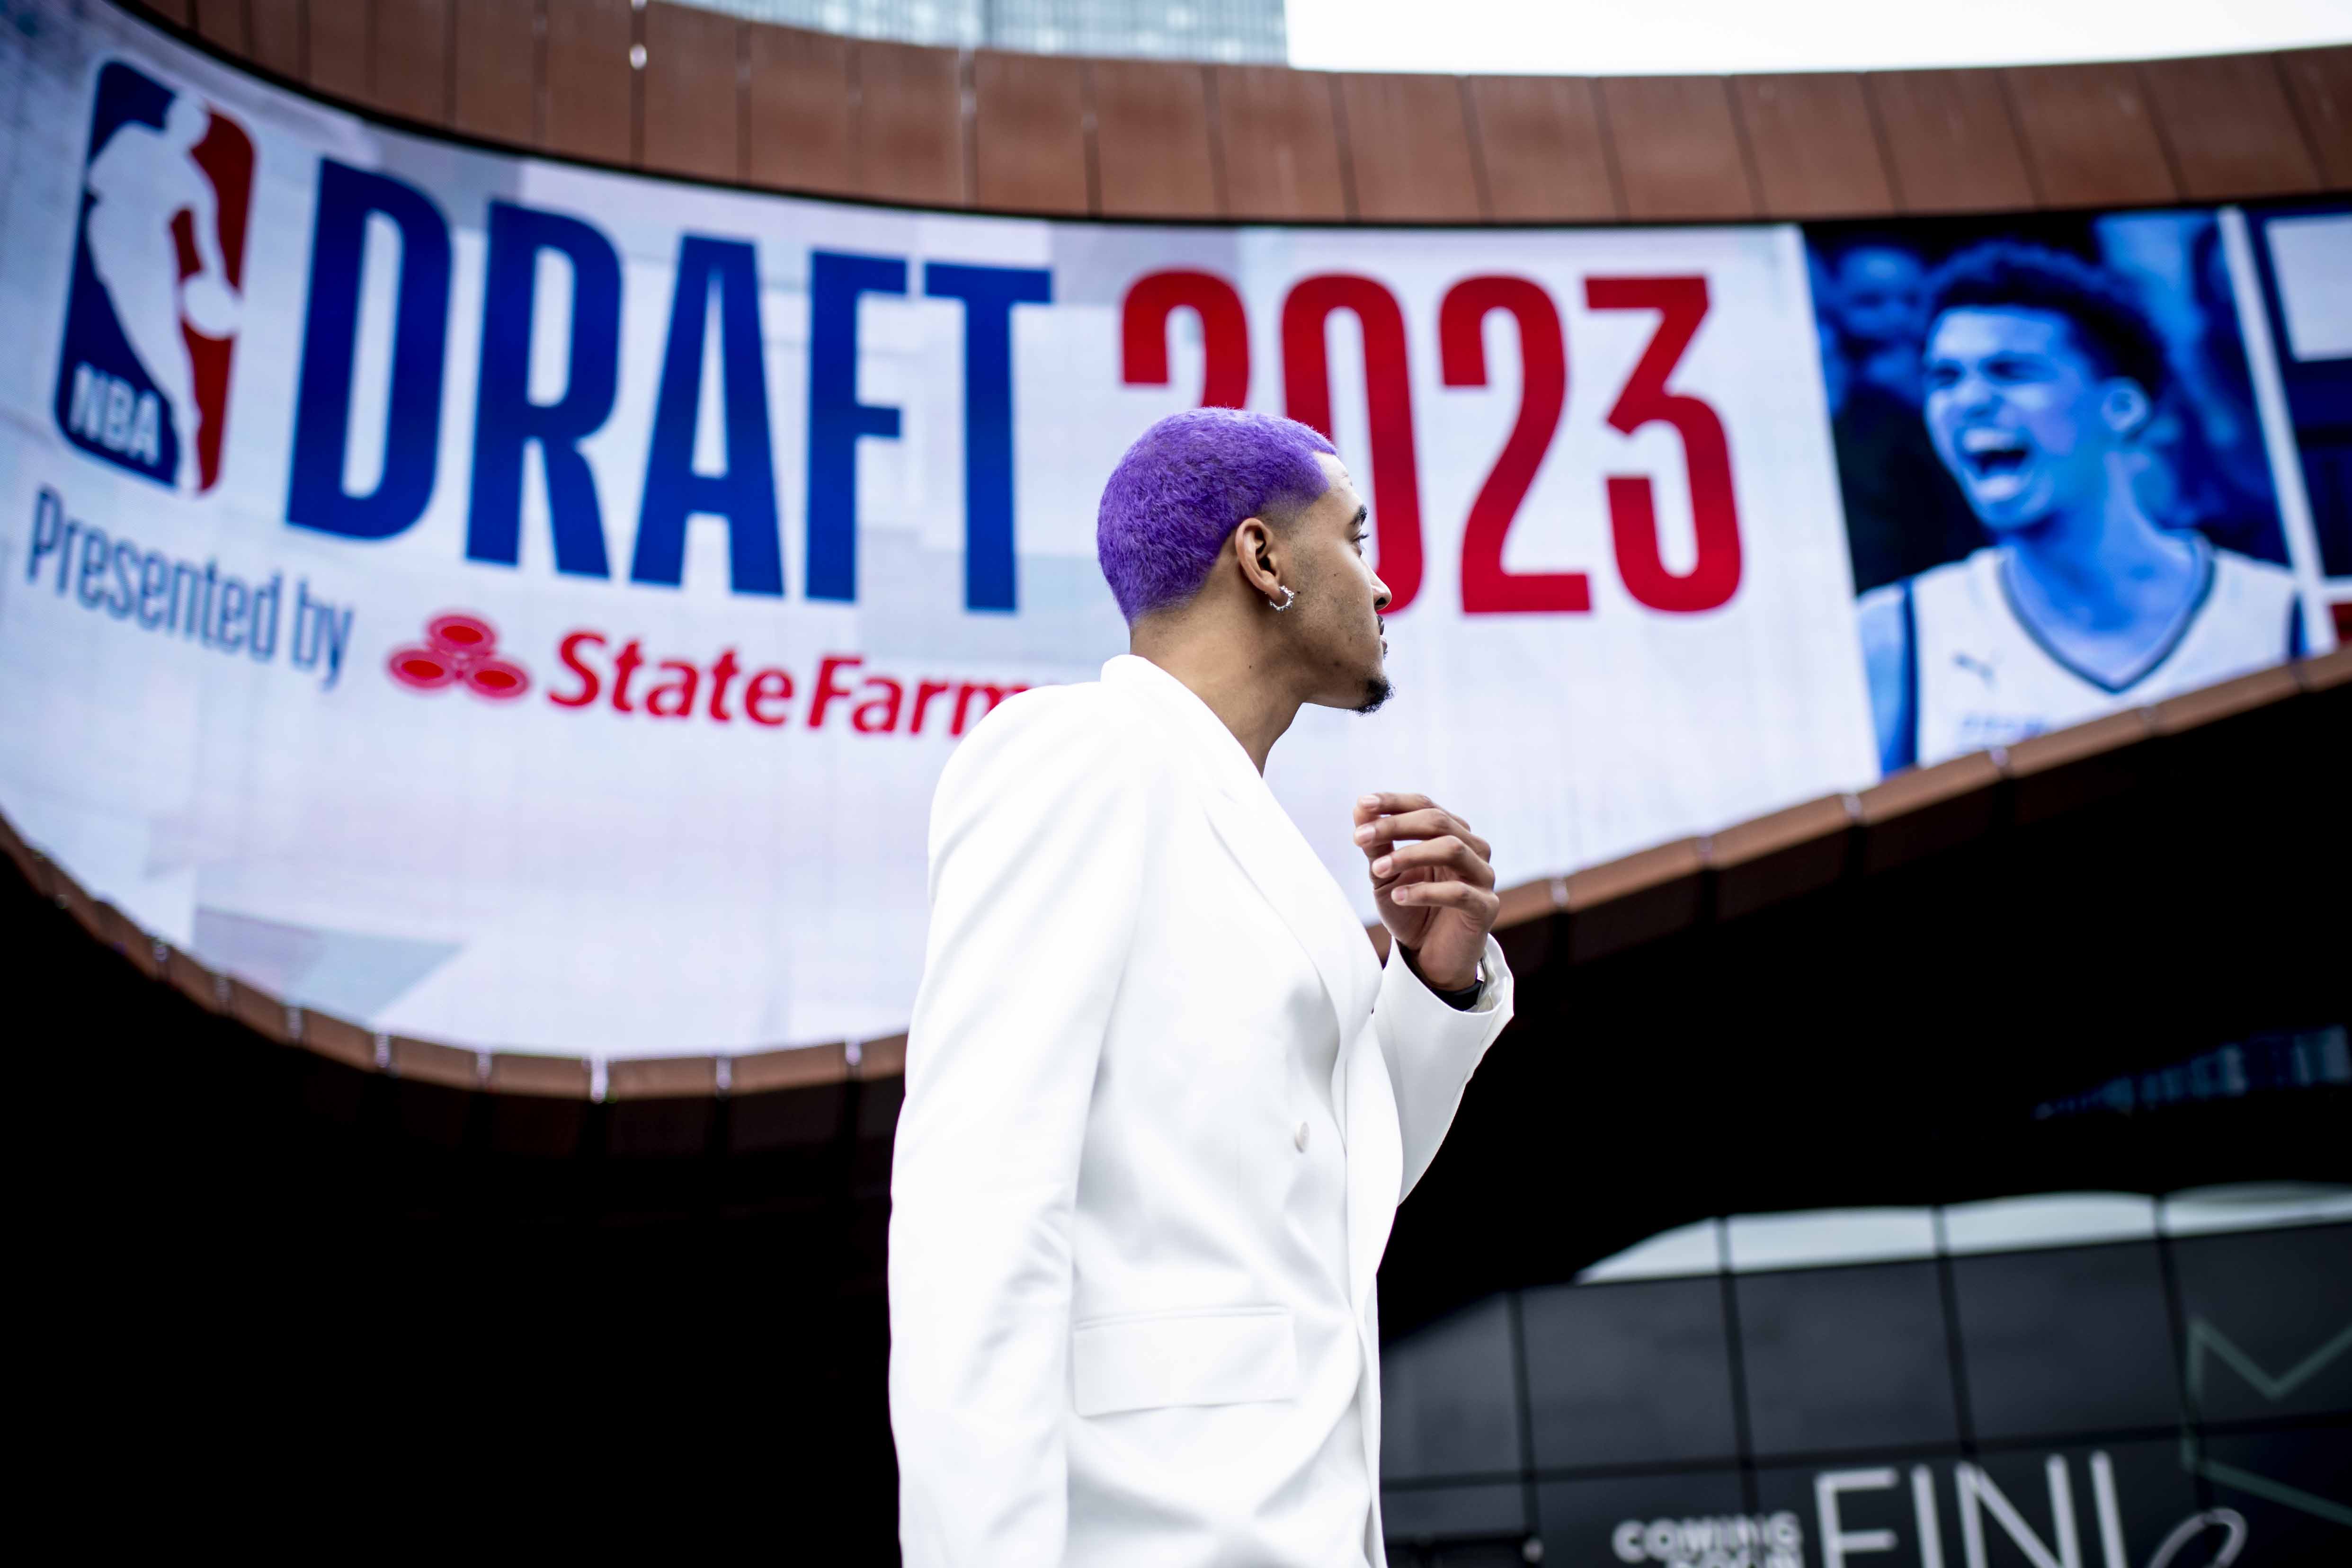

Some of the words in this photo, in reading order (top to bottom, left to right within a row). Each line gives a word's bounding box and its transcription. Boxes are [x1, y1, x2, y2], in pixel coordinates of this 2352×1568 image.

[69, 362, 160, 467] NBA
[285, 156, 1052, 613] DRAFT
[27, 486, 281, 661] Presented
[292, 579, 352, 689] by
